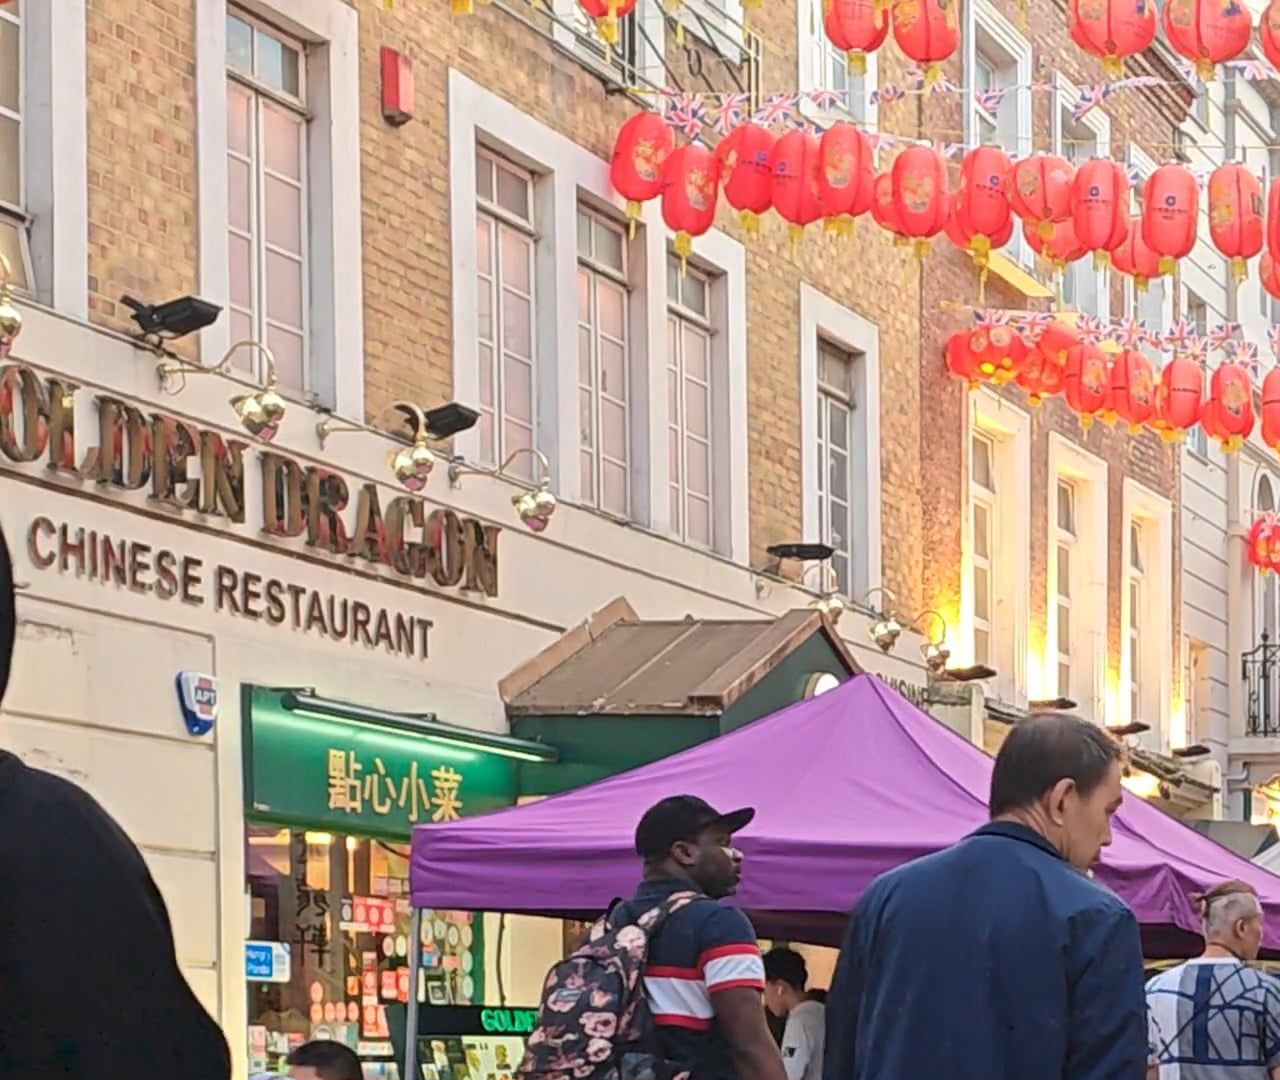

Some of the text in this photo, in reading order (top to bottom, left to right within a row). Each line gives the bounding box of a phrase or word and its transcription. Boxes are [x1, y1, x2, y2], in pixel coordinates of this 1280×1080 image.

[28, 516, 434, 659] CHINESE RESTAURANT
[260, 451, 501, 597] DRAGON
[327, 748, 464, 823] 點心小菜
